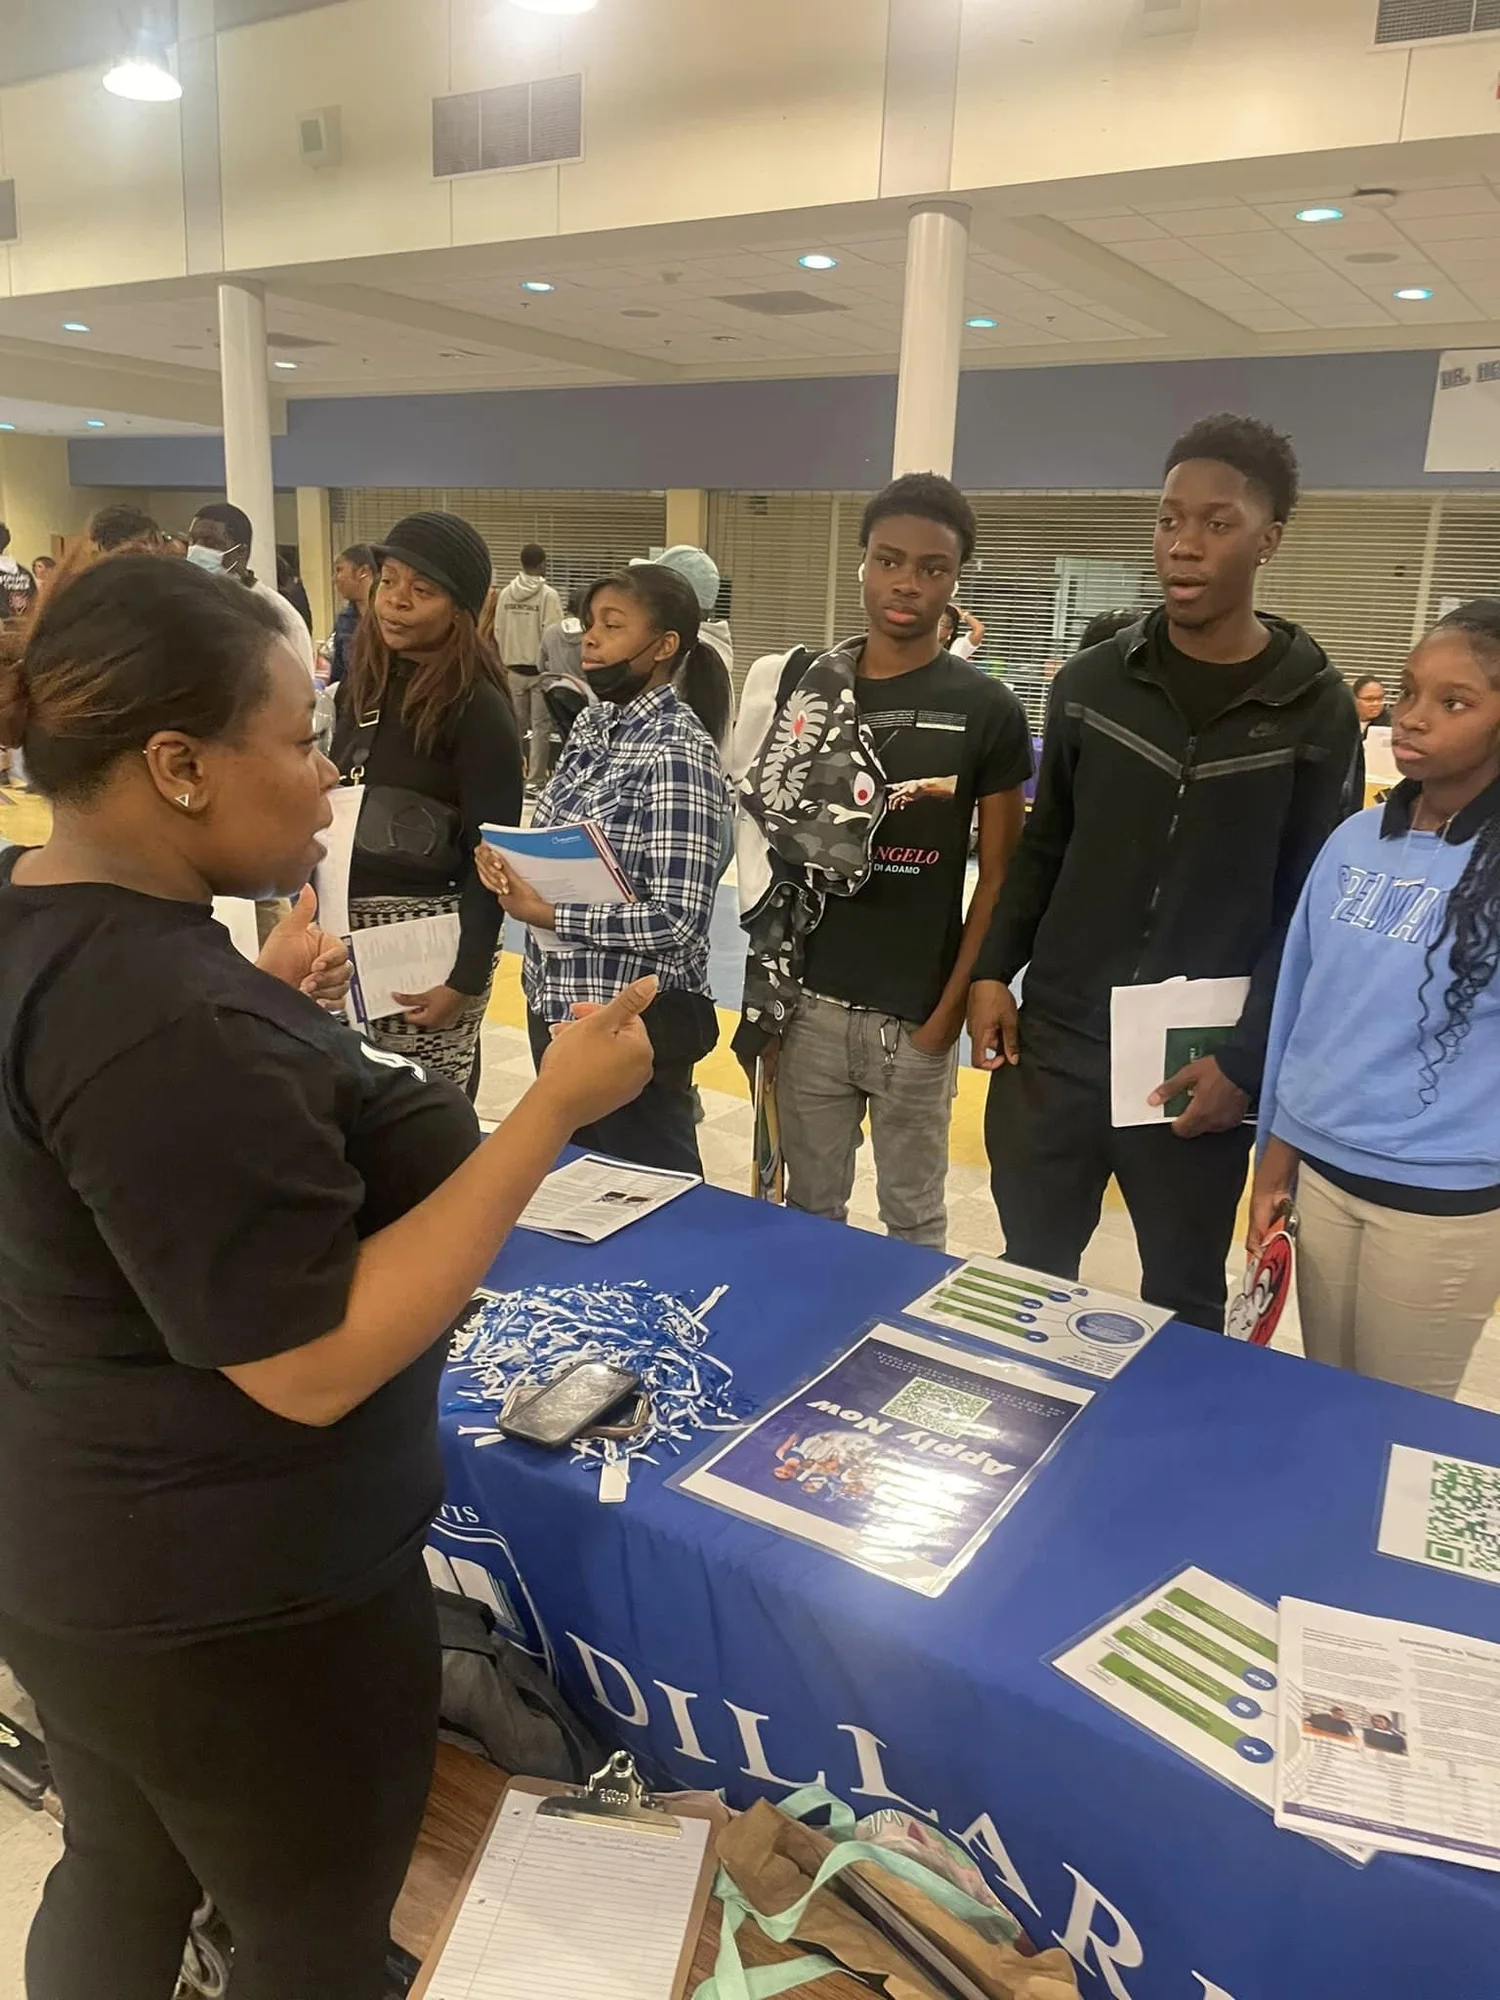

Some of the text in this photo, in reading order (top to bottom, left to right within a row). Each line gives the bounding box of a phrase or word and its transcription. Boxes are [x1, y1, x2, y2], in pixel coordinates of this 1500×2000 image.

[874, 846, 940, 865] NGELO
[874, 863, 920, 875] DI ADAMO
[806, 1400, 1017, 1477] Apply Now
[441, 1503, 480, 1523] TIS
[565, 1631, 1236, 2000] DILLAR
